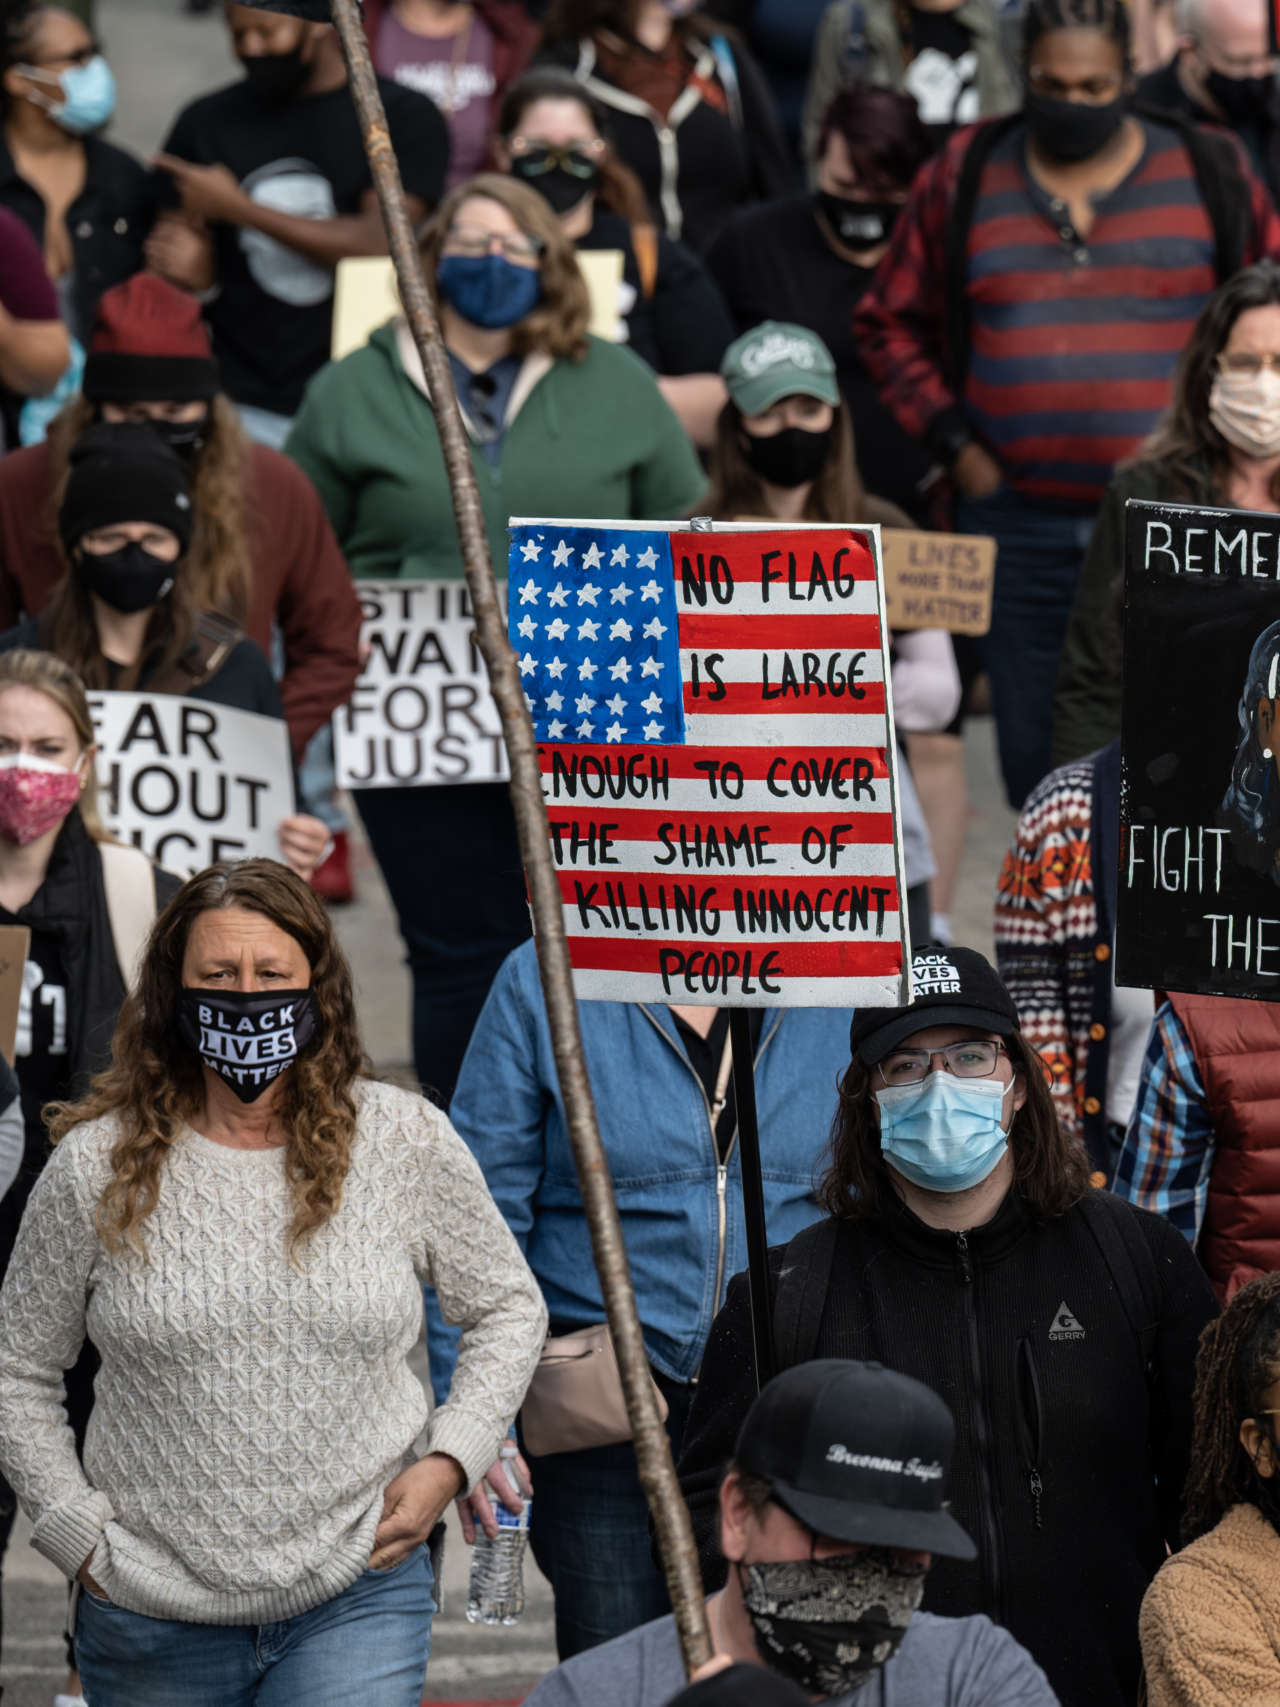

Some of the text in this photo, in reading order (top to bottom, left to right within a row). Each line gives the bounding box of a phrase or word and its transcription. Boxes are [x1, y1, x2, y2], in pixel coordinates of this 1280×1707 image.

[681, 547, 856, 607] NO FLAG
[690, 650, 867, 701] IS LARGE
[345, 684, 487, 733] FOR
[693, 759, 745, 800] TO
[765, 756, 877, 802] COVER
[549, 821, 854, 869] THE SHAME OF
[1127, 825, 1232, 894] FIGHT
[573, 879, 892, 938] KILLING INNOCENT
[659, 947, 783, 996] PEOPLE
[198, 1004, 296, 1033] BLACK
[201, 1030, 295, 1061] LIVES
[1048, 1331, 1086, 1341] GERRY
[825, 1443, 904, 1473] Breonna
